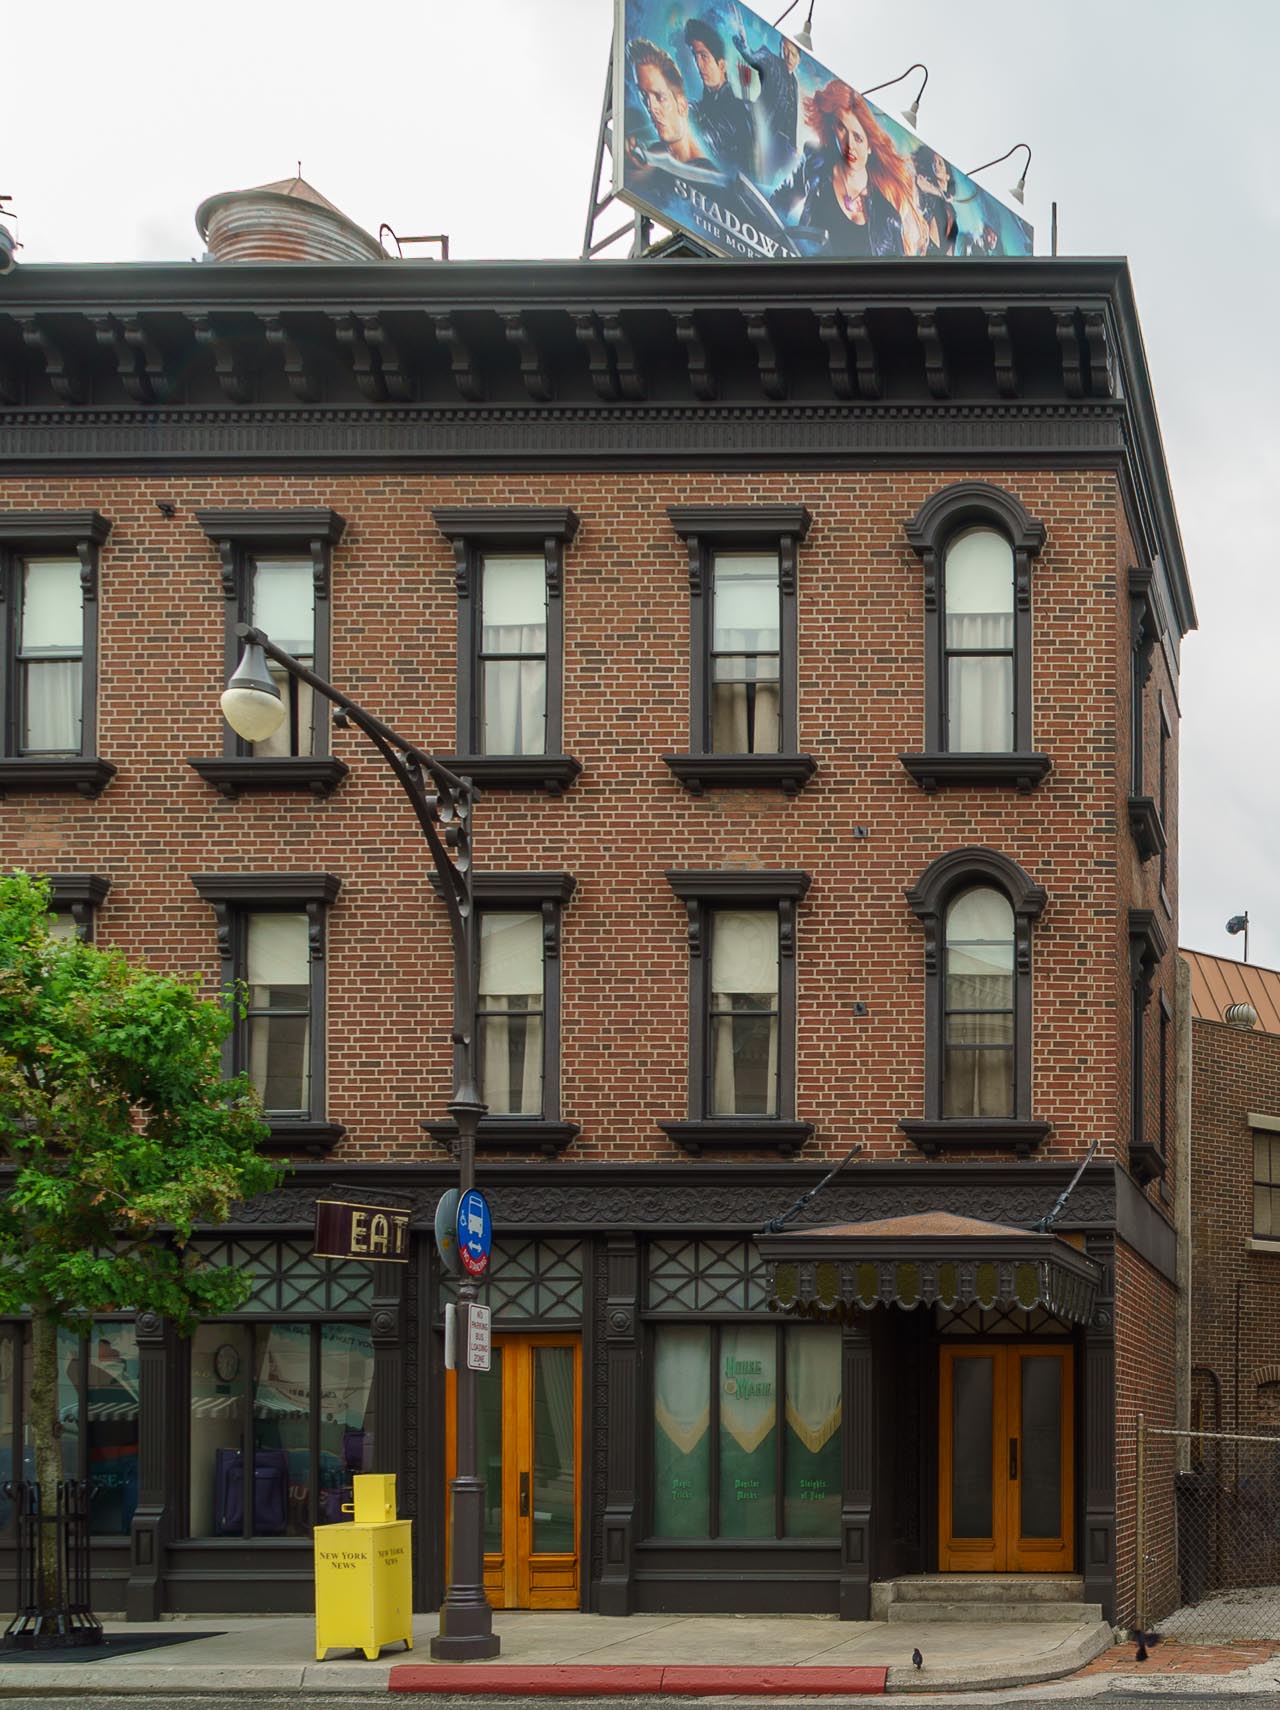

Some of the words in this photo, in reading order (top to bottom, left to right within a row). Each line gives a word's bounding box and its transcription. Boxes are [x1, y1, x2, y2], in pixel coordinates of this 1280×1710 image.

[694, 214, 720, 239] THE
[351, 1211, 409, 1254] EAT
[471, 1321, 488, 1331] PARKING
[475, 1332, 484, 1341] BUS
[471, 1343, 488, 1353] LOADING
[474, 1353, 486, 1363] ZONE
[319, 1551, 338, 1560] NEW
[342, 1552, 367, 1560] YORK
